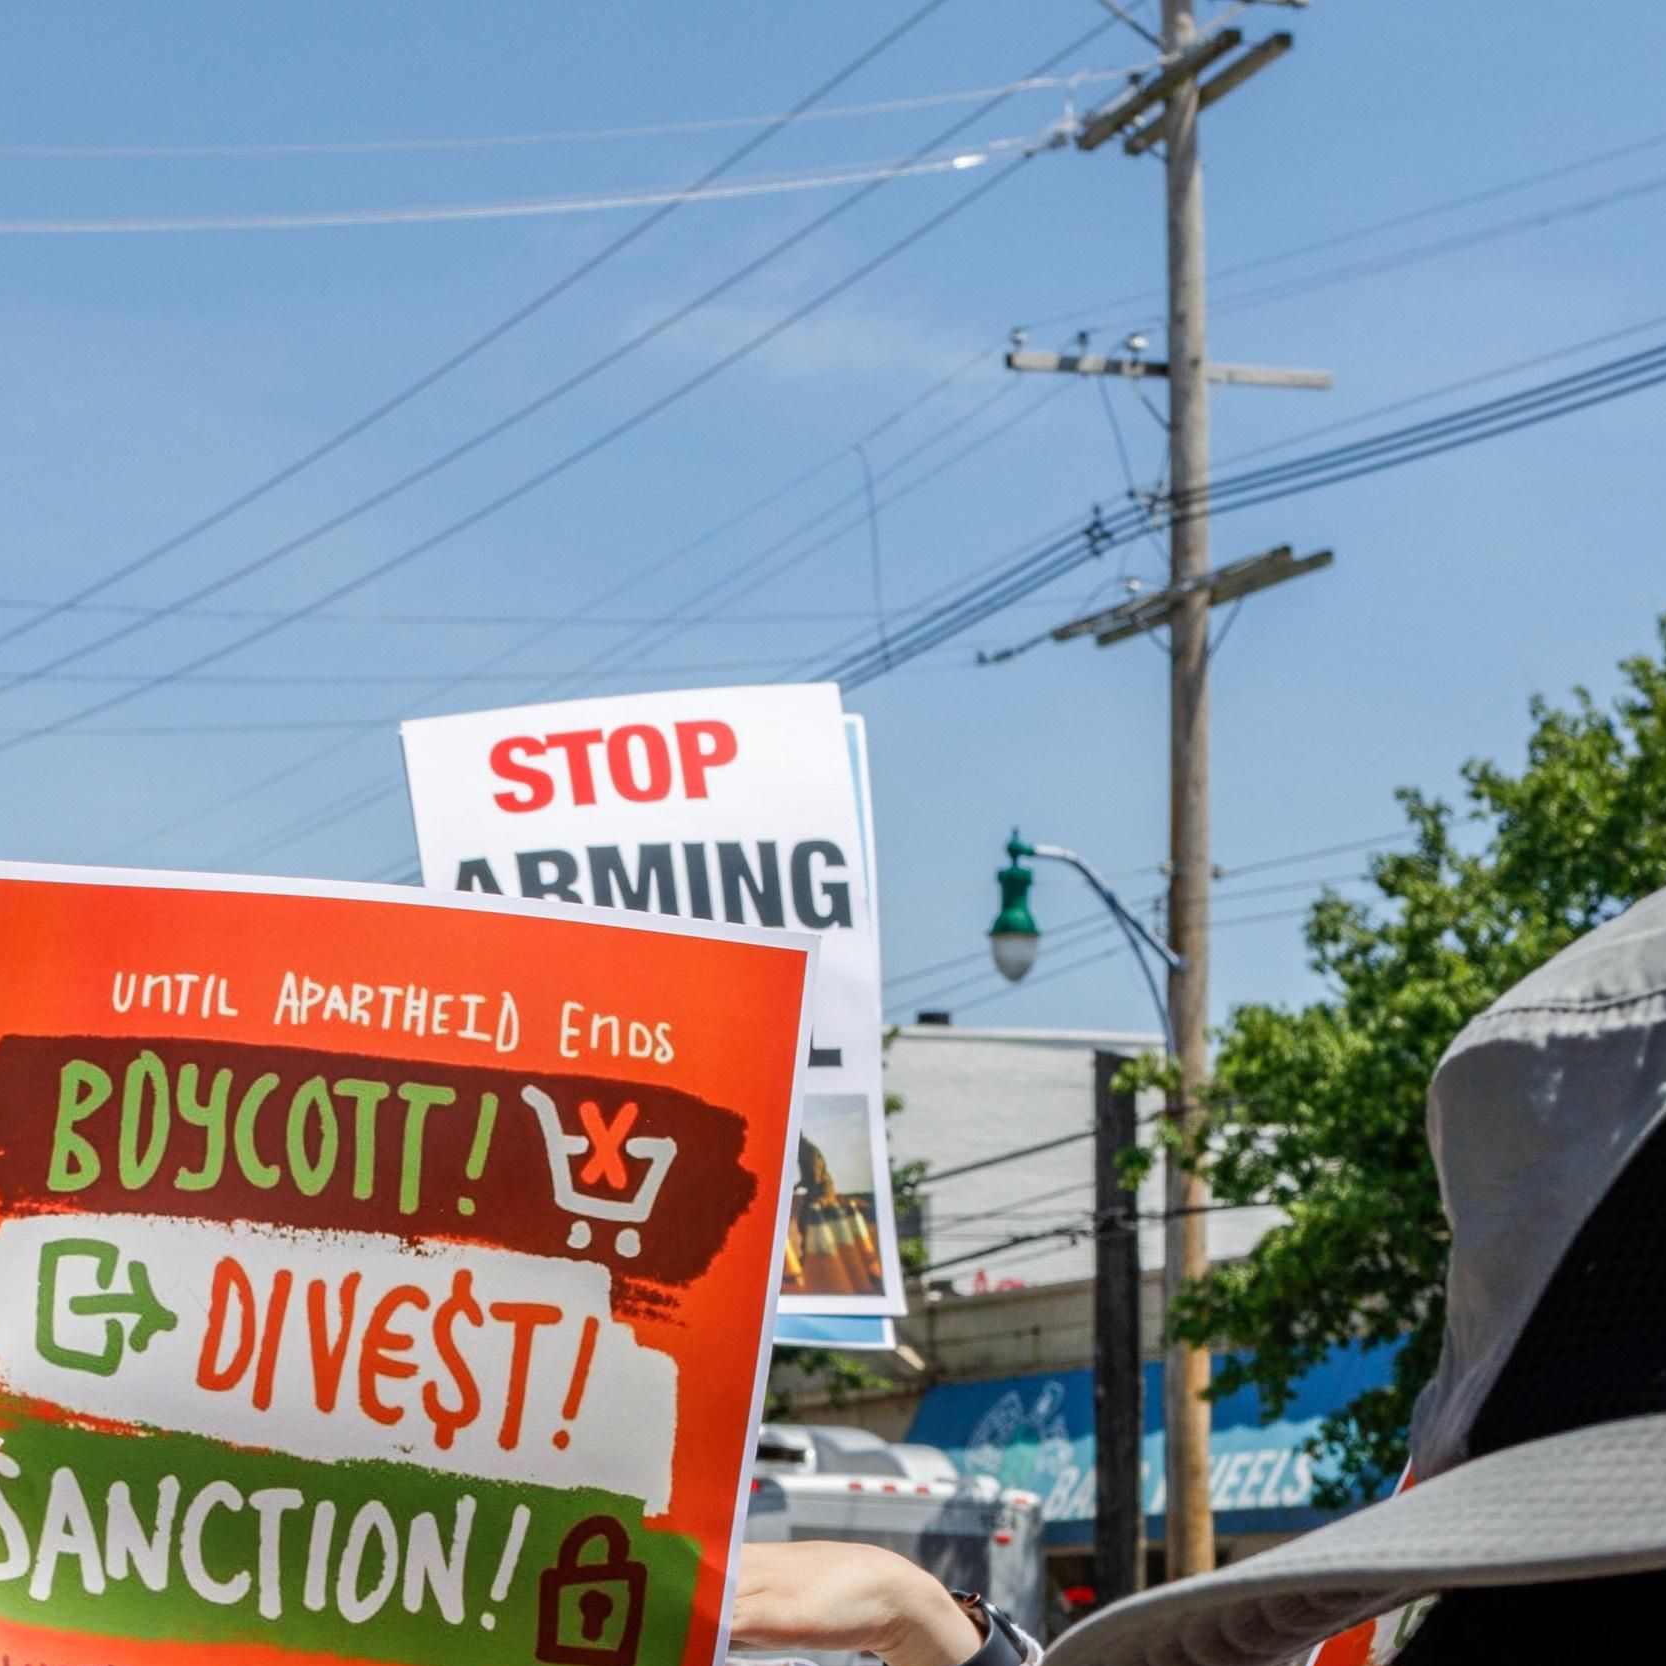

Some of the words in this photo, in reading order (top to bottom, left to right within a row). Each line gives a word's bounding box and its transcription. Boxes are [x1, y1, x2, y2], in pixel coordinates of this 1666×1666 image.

[488, 719, 739, 814] STOP
[273, 970, 520, 1053] APARTHEID
[47, 1050, 498, 1216] BOYCOTT!
